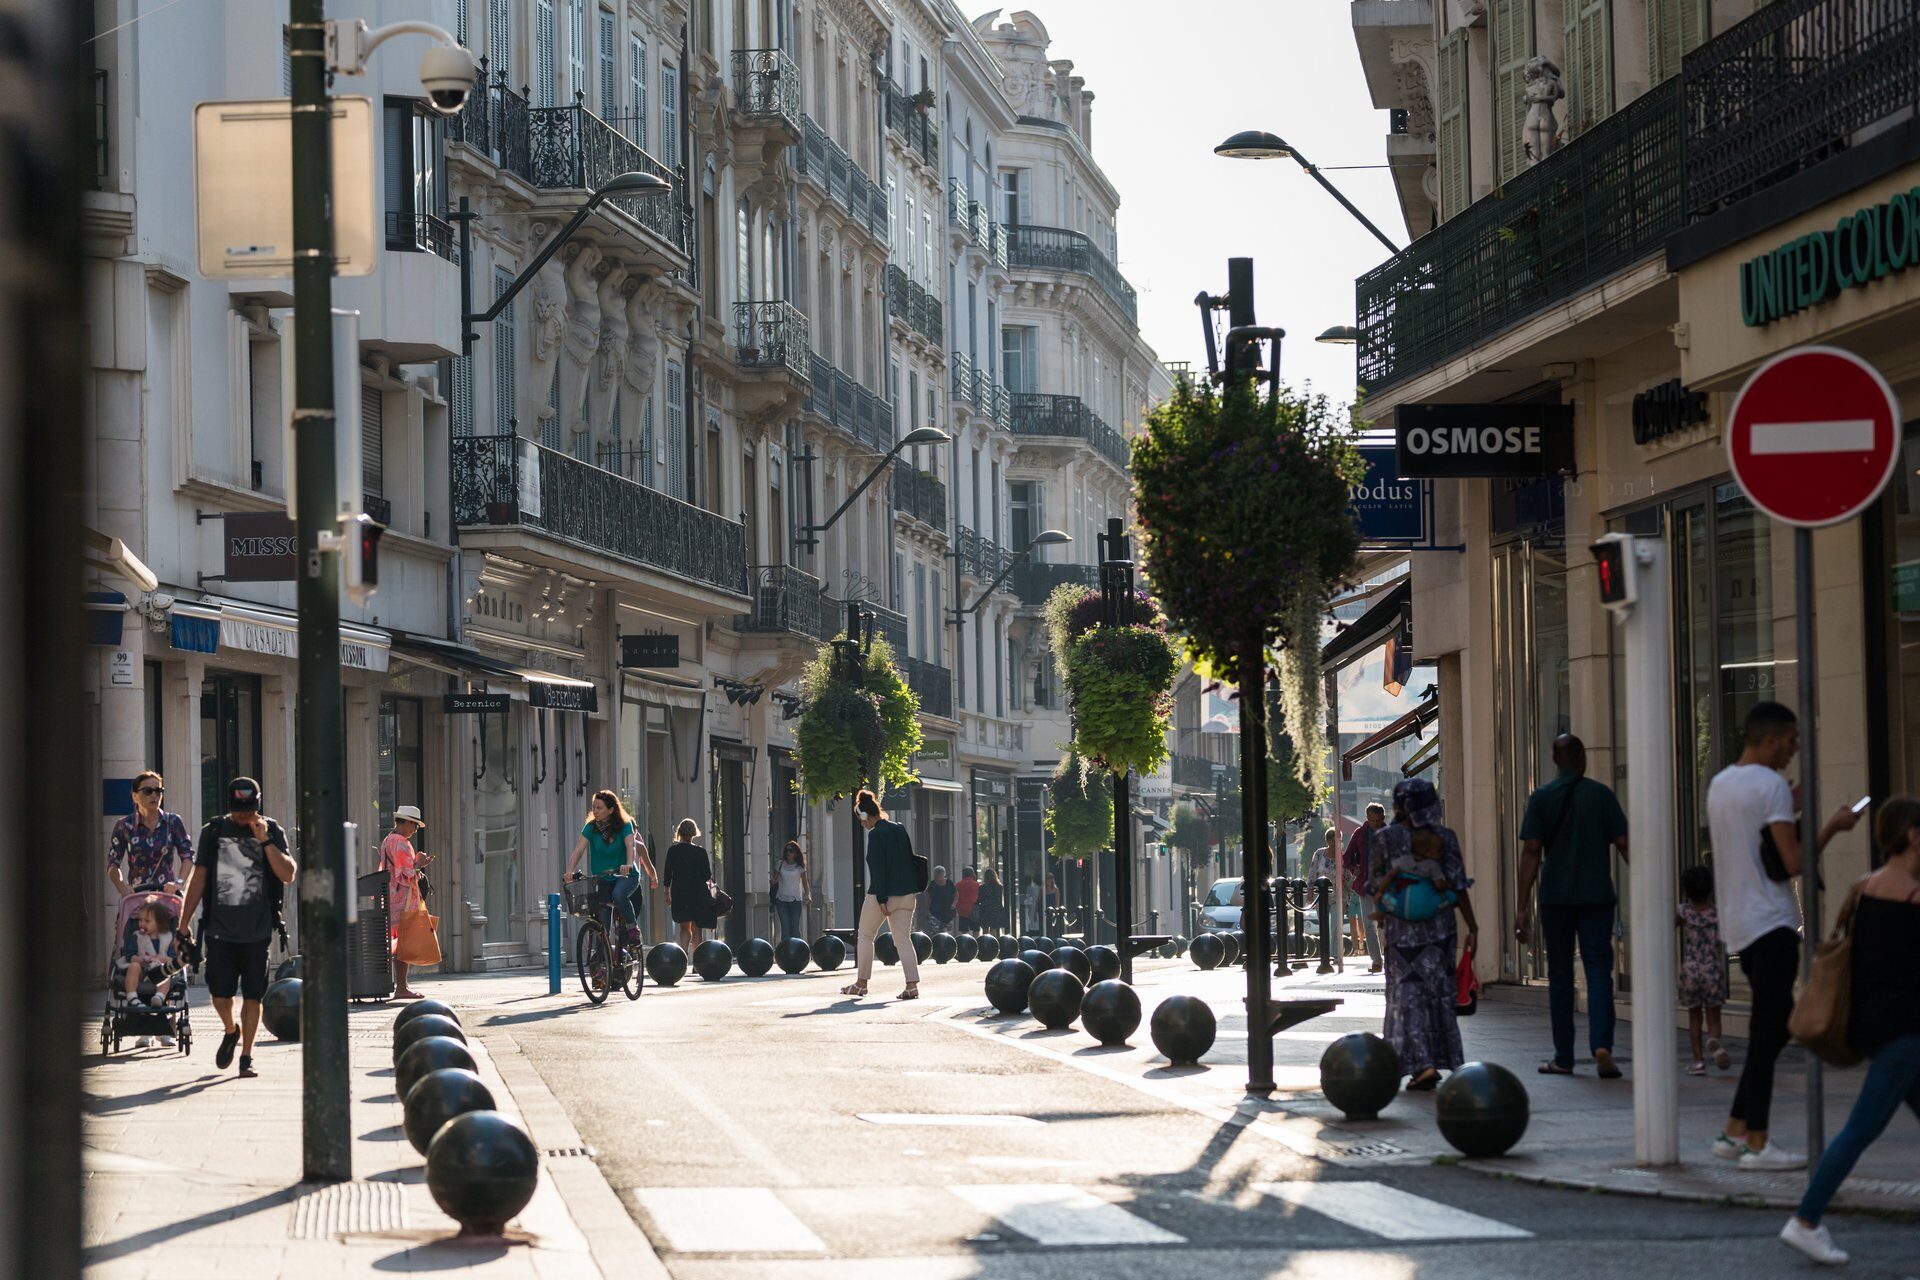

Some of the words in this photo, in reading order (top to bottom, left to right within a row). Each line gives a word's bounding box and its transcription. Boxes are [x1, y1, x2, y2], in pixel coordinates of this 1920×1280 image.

[1739, 230, 1830, 328] UNITED
[1406, 427, 1541, 455] OSMOSE
[231, 536, 298, 557] MISSO
[476, 591, 523, 624] sandro
[245, 626, 287, 656] CASADEI
[624, 647, 678, 655] sandro
[116, 652, 128, 663] 99
[453, 700, 502, 709] Berenice
[546, 684, 582, 708] Berenice
[1140, 786, 1171, 794] CANNES
